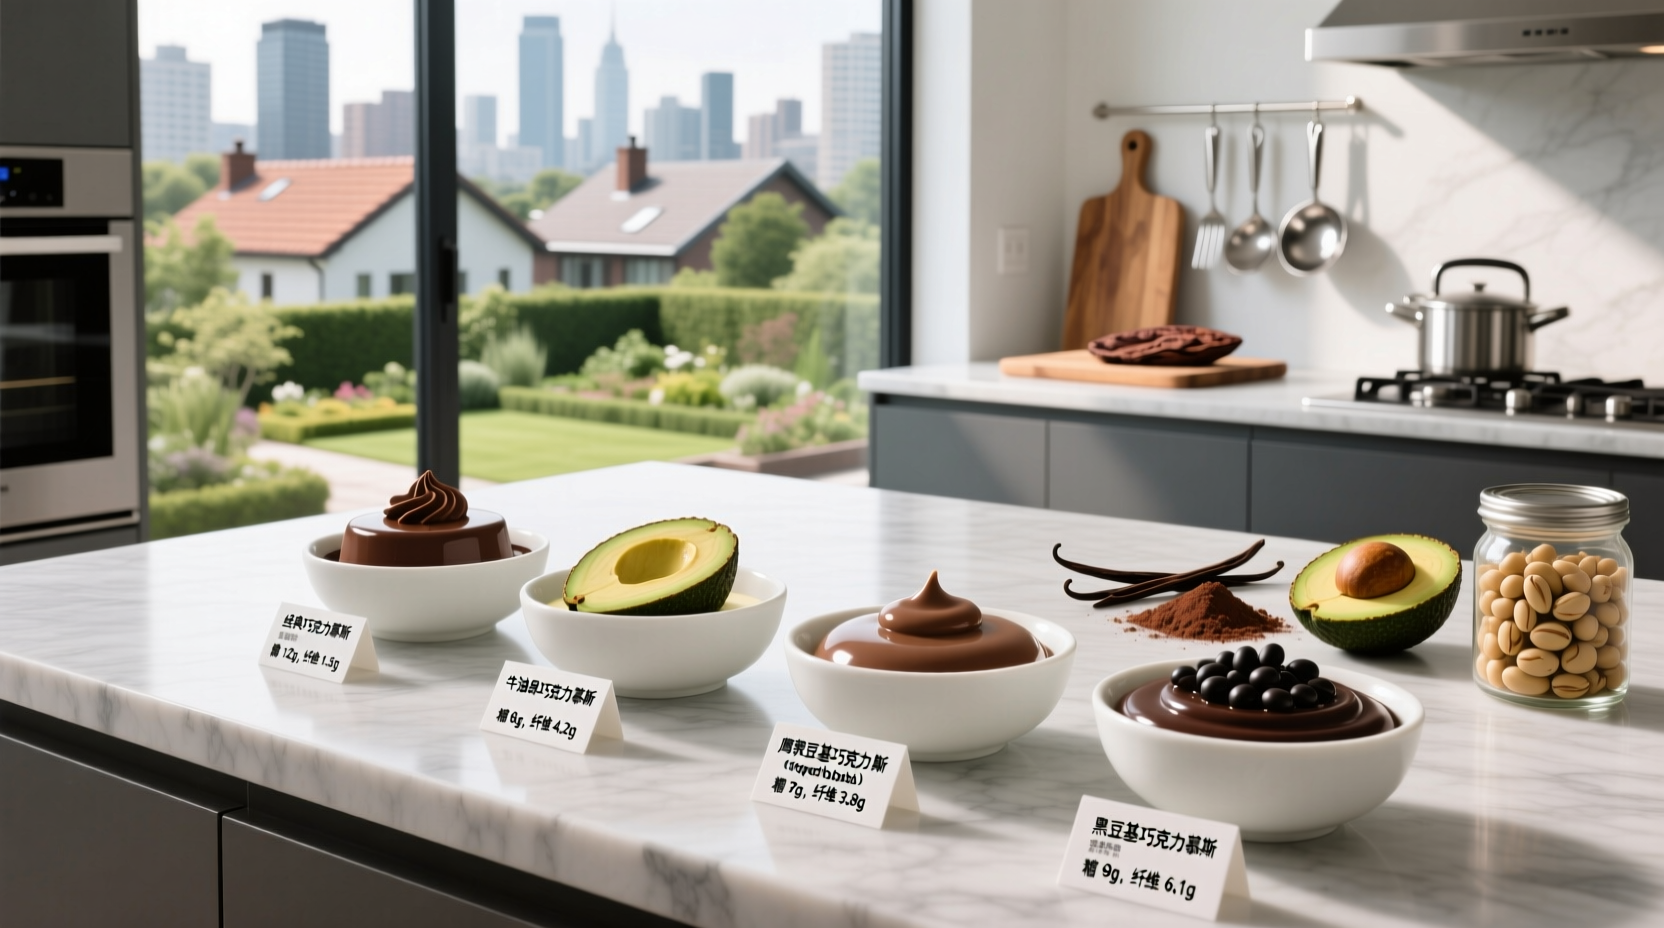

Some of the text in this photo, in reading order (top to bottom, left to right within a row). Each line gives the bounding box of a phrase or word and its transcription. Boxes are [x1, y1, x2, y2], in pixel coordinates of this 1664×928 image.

[553, 720, 577, 740] 4.2g
[839, 791, 865, 812] 3.8g
[1130, 867, 1160, 890] 纤维
[1164, 877, 1196, 902] 6.1g
